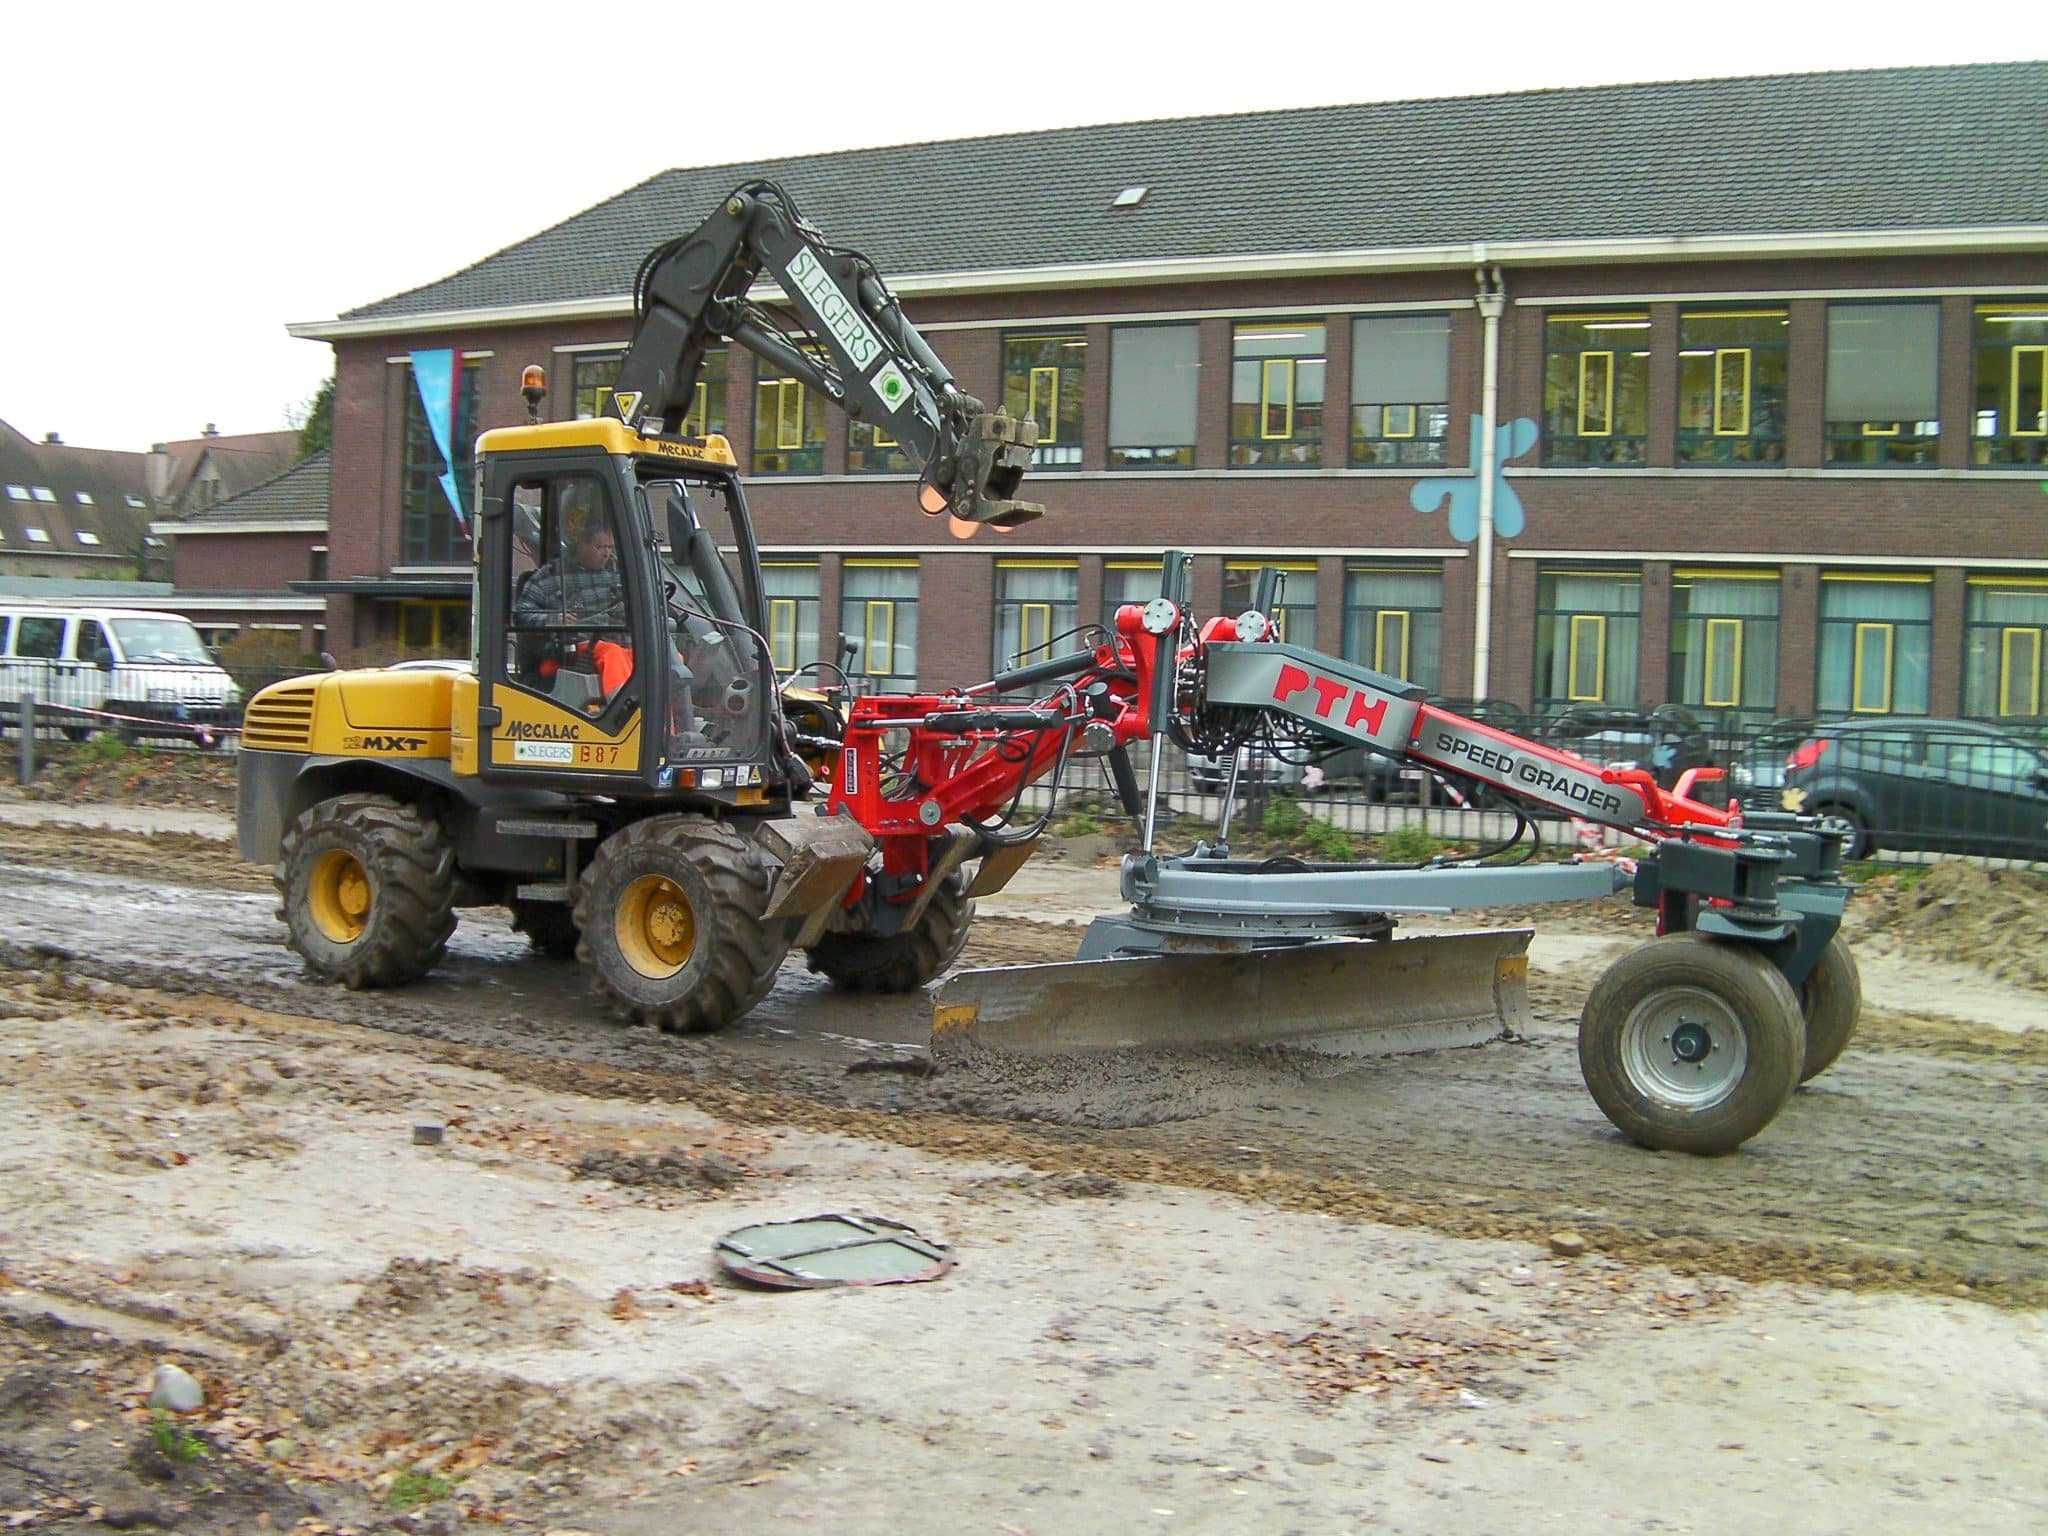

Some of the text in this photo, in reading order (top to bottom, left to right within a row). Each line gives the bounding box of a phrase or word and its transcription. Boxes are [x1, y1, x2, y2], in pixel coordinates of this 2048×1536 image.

[790, 252, 876, 362] SLEGERS
[1273, 664, 1388, 736] PTH
[528, 745, 571, 758] SLEGERS
[1436, 733, 1621, 814] SPEED GRADER
